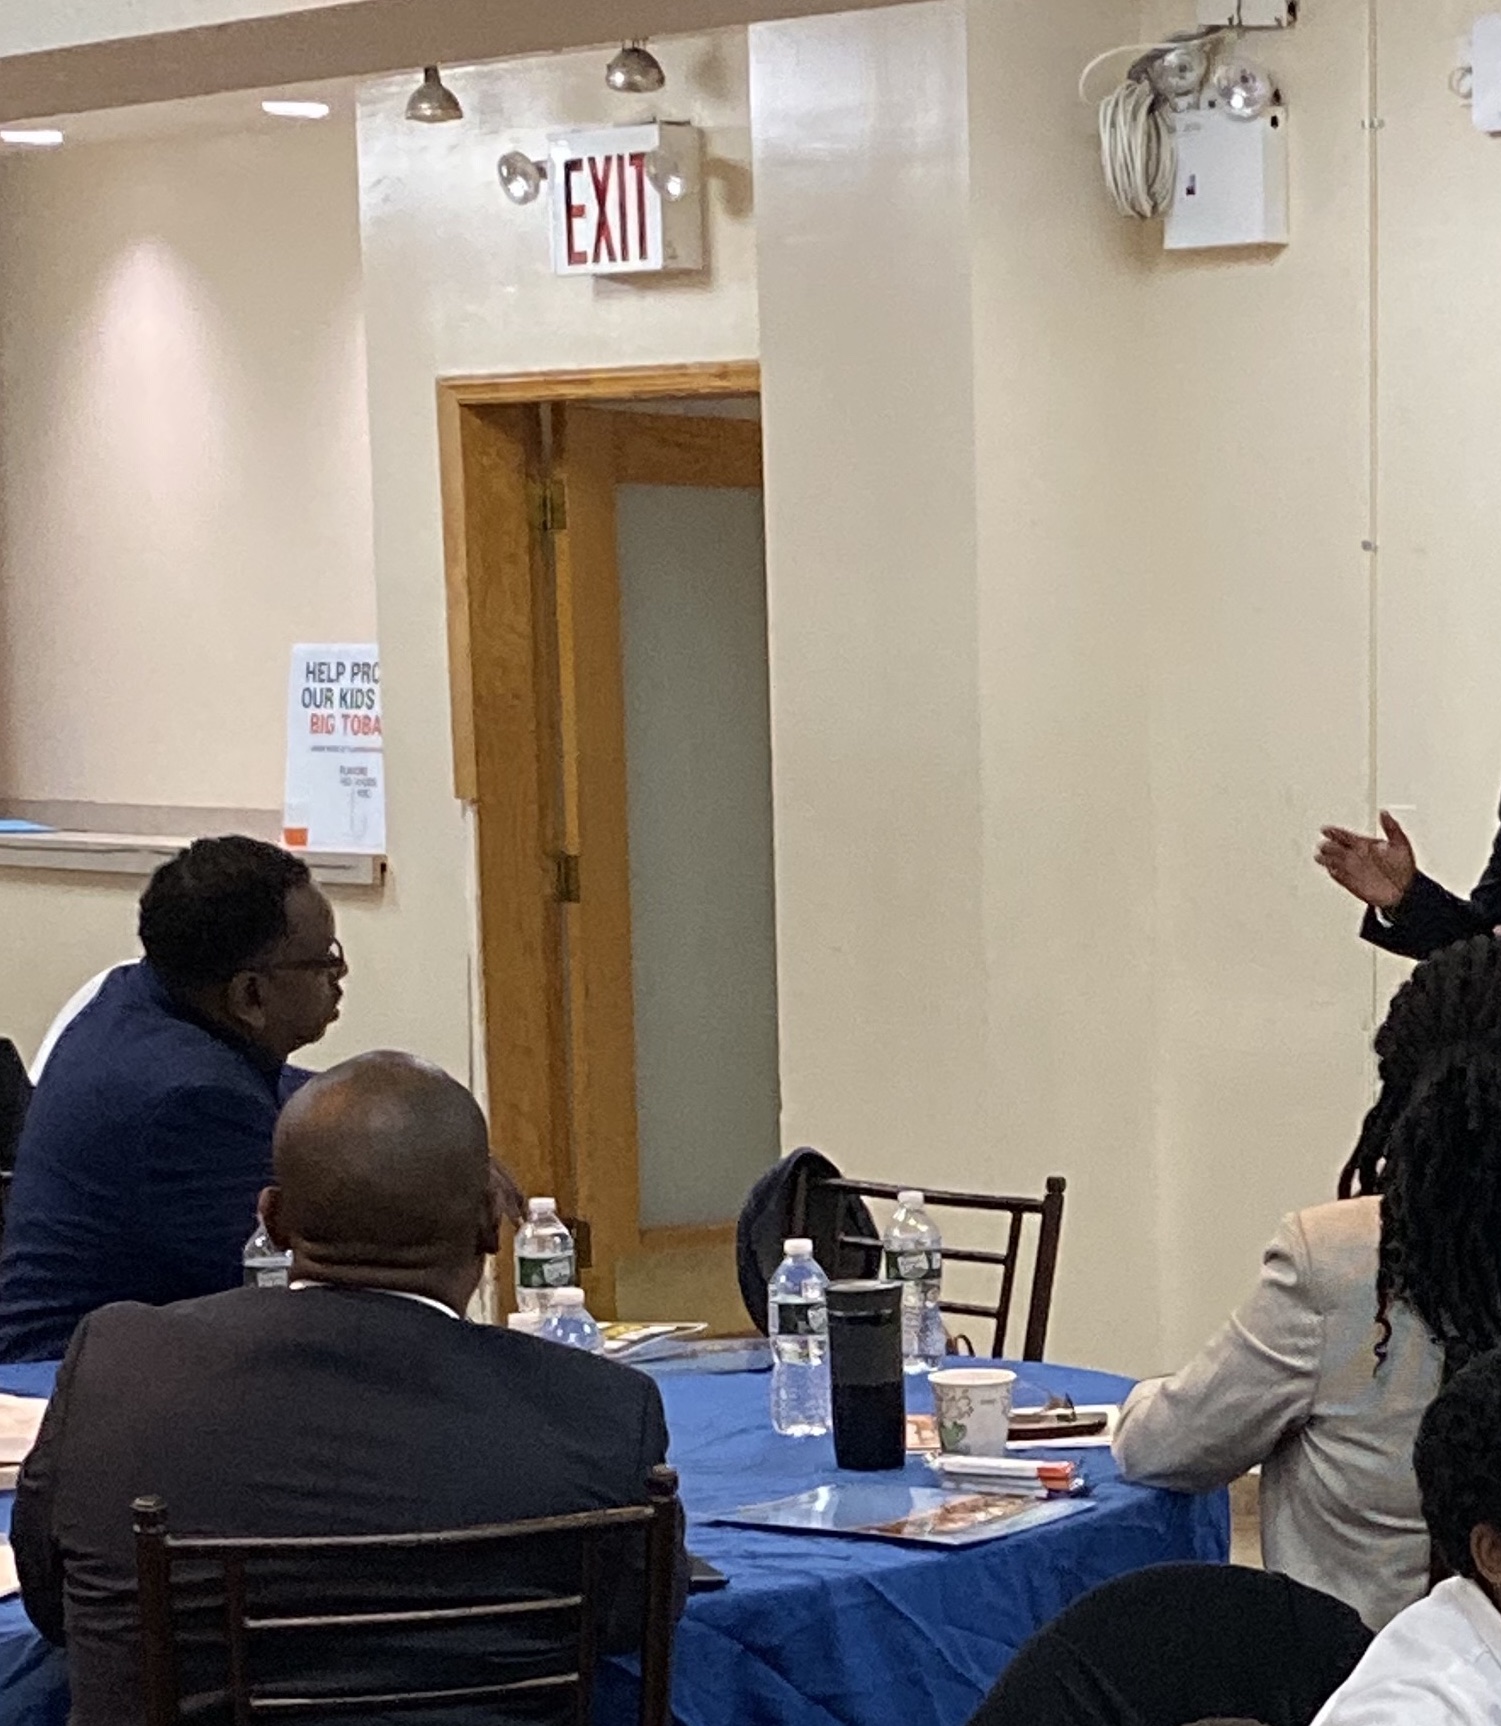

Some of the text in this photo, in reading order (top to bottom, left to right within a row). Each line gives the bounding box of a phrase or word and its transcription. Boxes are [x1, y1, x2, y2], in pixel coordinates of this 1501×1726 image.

[564, 152, 648, 266] EXIT
[305, 661, 346, 683] HELP
[301, 687, 376, 711] OUR KIDS
[309, 713, 382, 737] BIG TOBA
